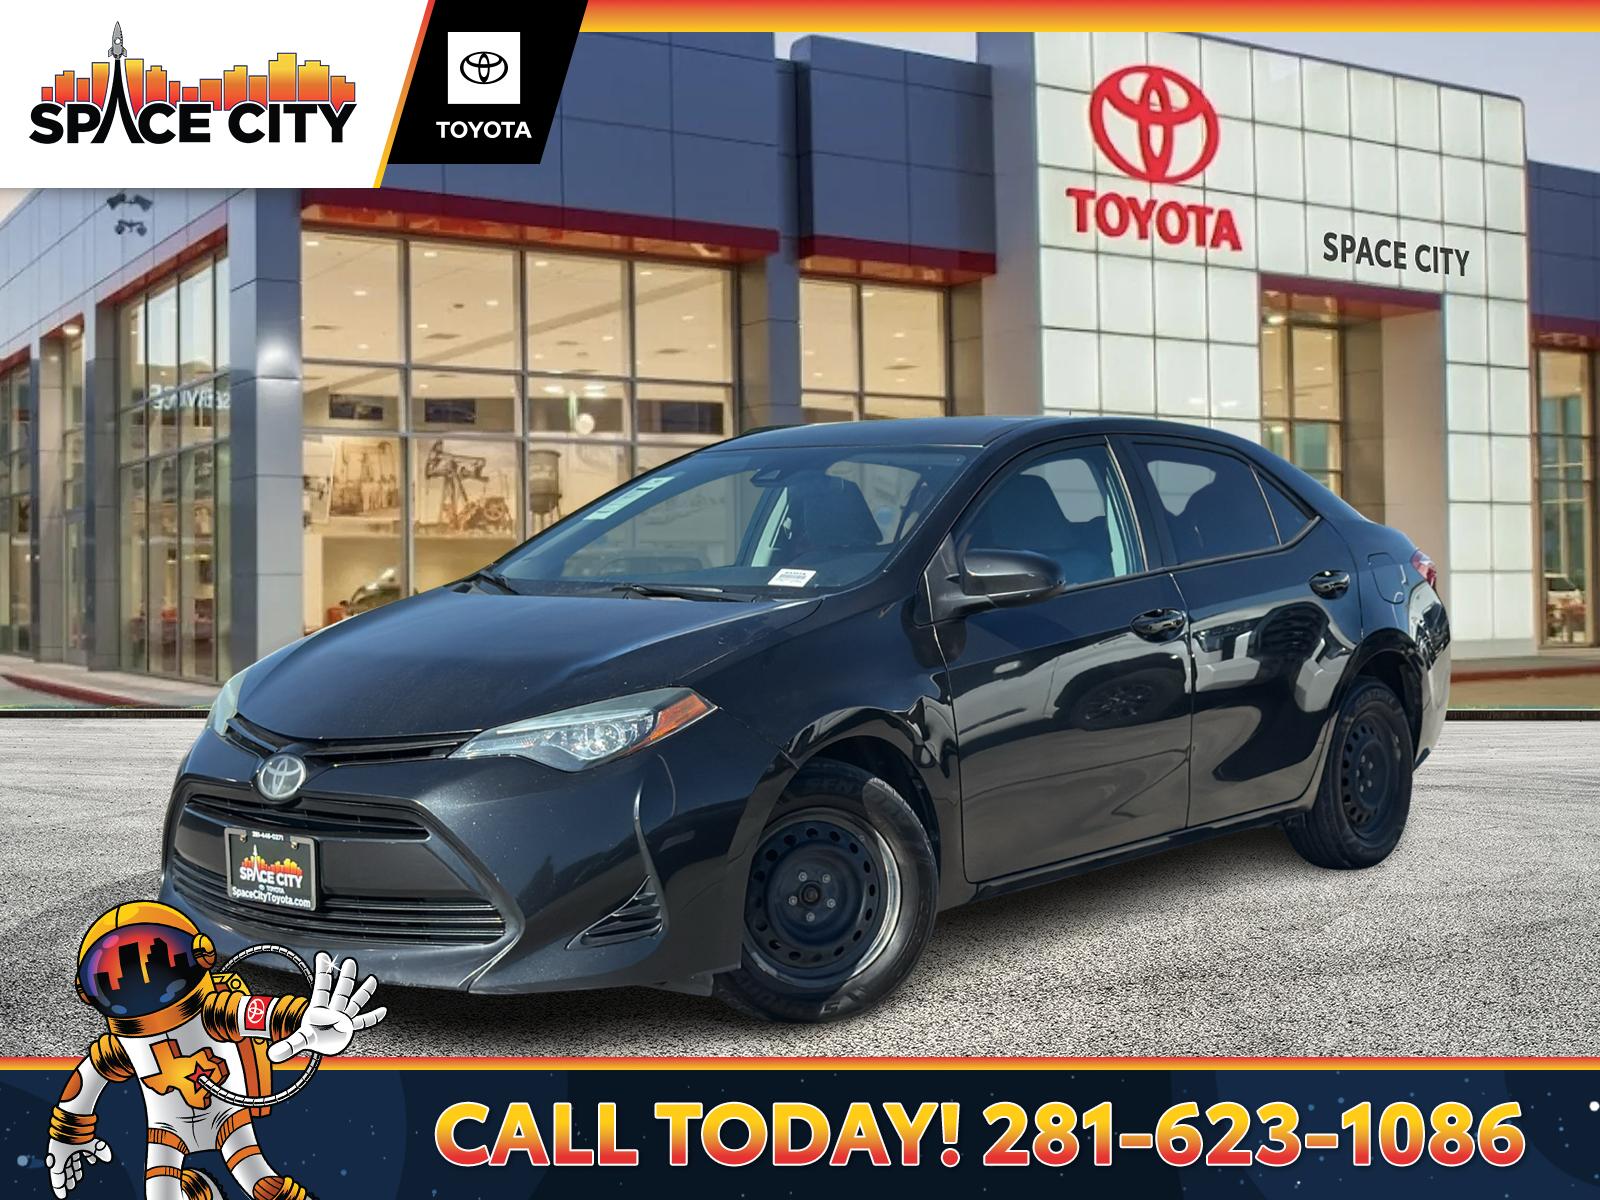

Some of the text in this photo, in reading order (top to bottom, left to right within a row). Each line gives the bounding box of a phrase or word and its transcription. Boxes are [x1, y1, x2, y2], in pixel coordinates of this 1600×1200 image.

[1066, 188, 1243, 252] TOYOTA
[1322, 231, 1471, 277] SPACE CITY
[240, 866, 303, 888] SPACE CITY
[232, 886, 311, 907] SpaceCityToyota.com
